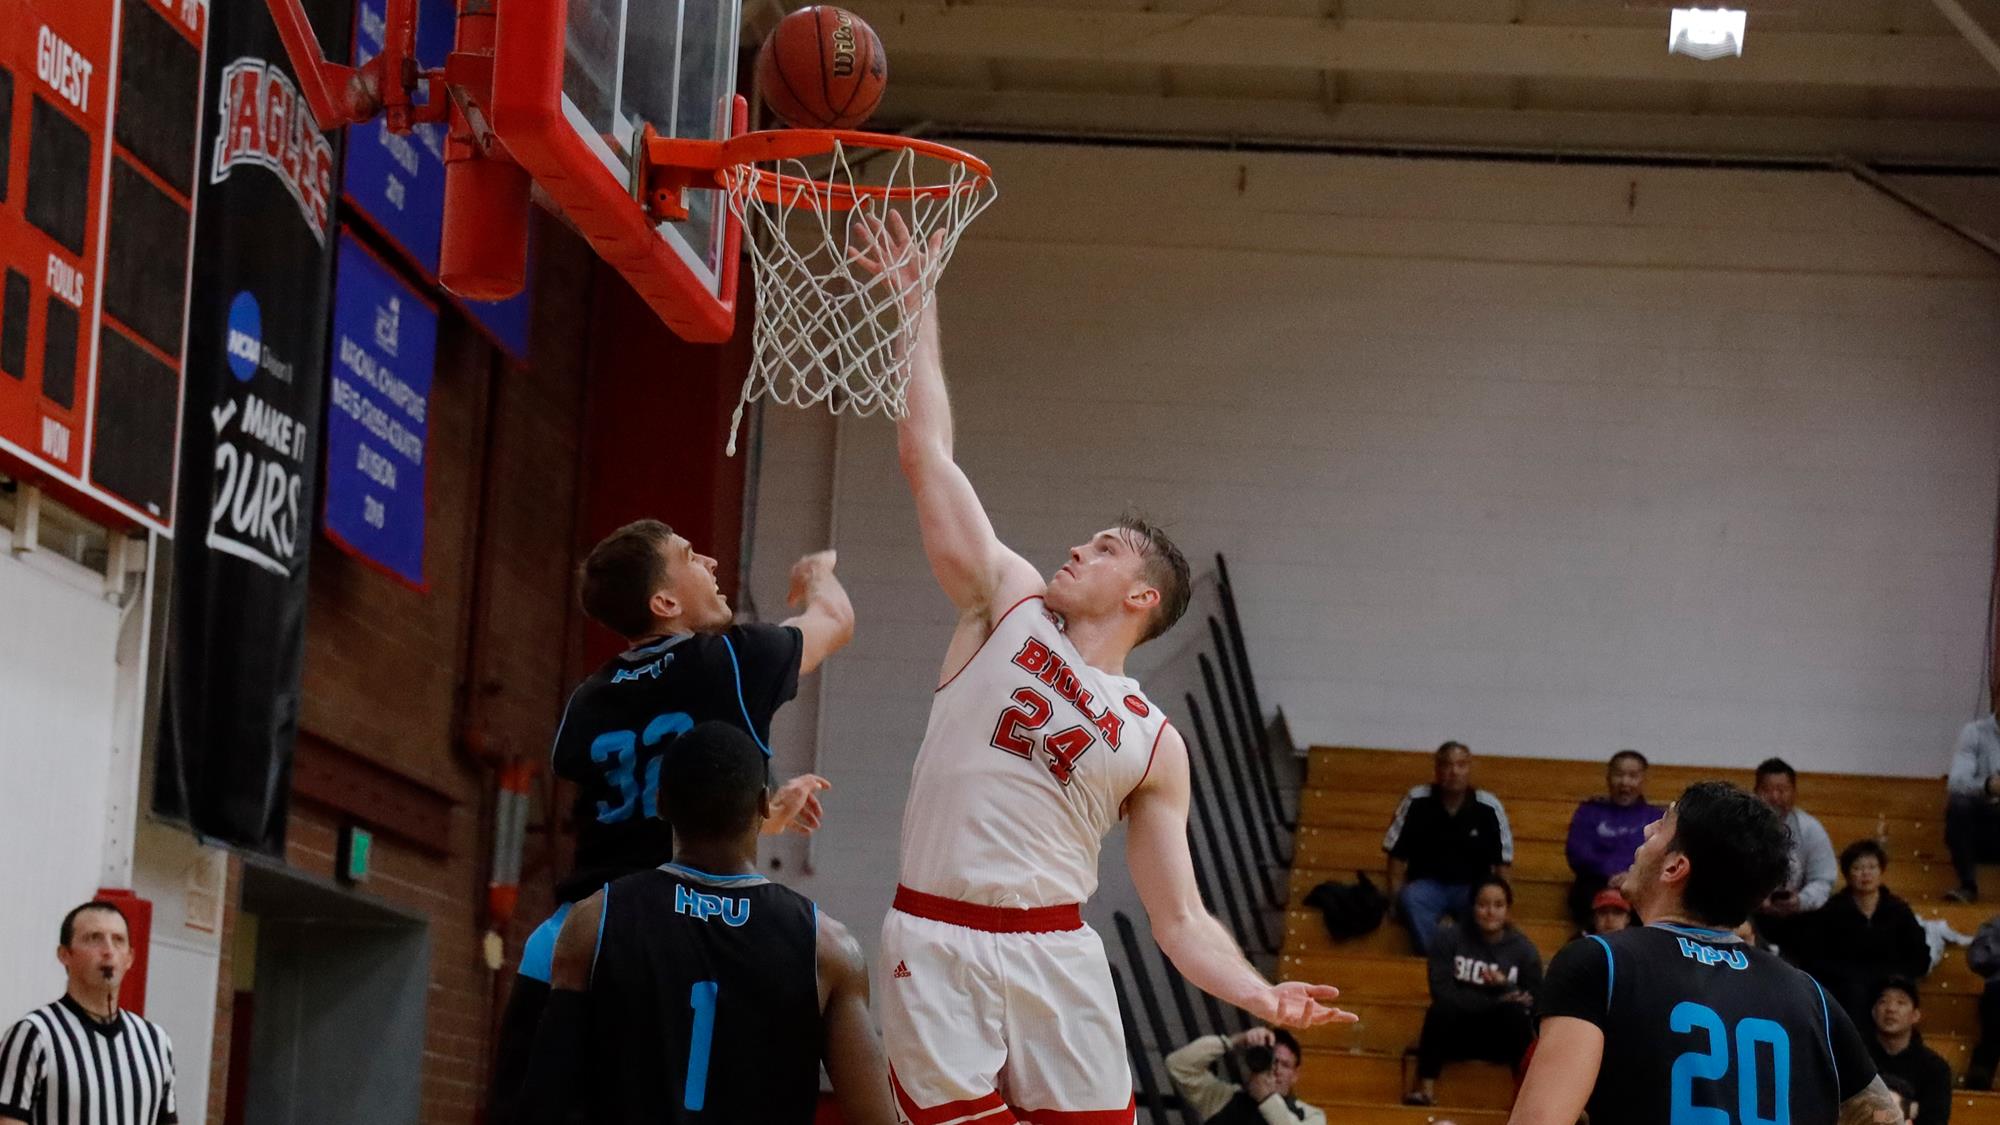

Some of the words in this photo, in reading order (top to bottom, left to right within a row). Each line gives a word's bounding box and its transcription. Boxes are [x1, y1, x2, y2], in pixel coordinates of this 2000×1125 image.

[37, 25, 93, 114] GUEST
[46, 253, 84, 308] FOULS
[42, 415, 71, 464] WON
[241, 393, 293, 456] MAKE
[1011, 636, 1125, 752] BIOLA
[990, 686, 1096, 786] 24
[675, 883, 750, 927] HPU
[1676, 937, 1749, 970] HPU
[684, 981, 718, 1111] 1
[1669, 1001, 1791, 1125] 20
